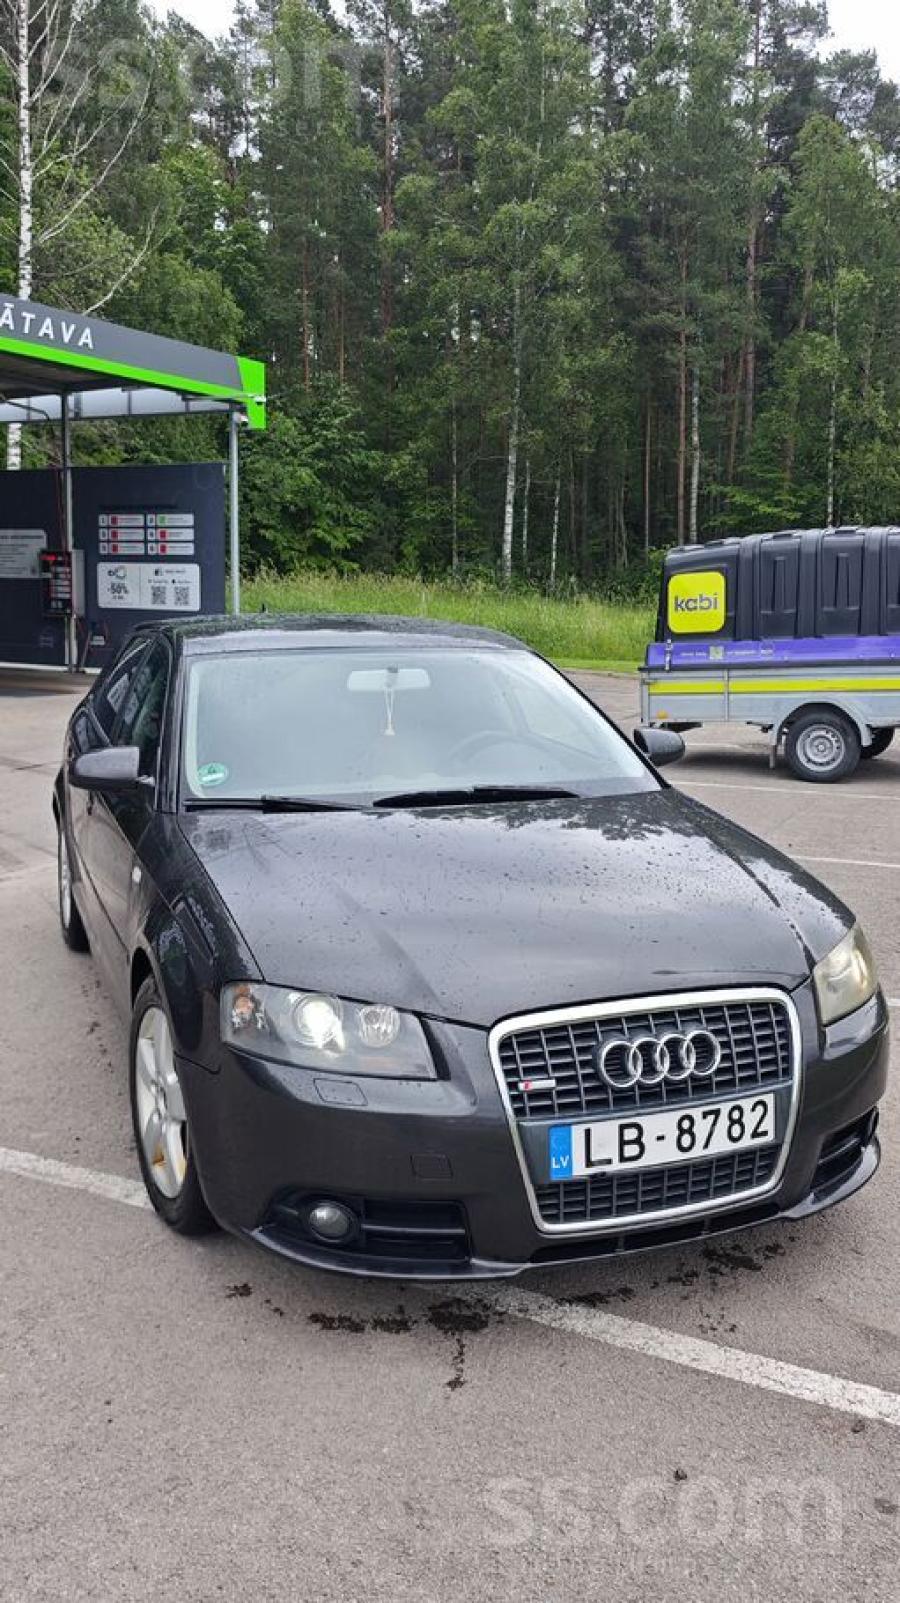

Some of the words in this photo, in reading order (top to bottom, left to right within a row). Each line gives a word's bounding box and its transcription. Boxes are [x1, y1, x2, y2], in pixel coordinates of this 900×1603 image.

[674, 593, 719, 613] kabi
[584, 1099, 769, 1169] LB-8782
[551, 1154, 570, 1169] LV
